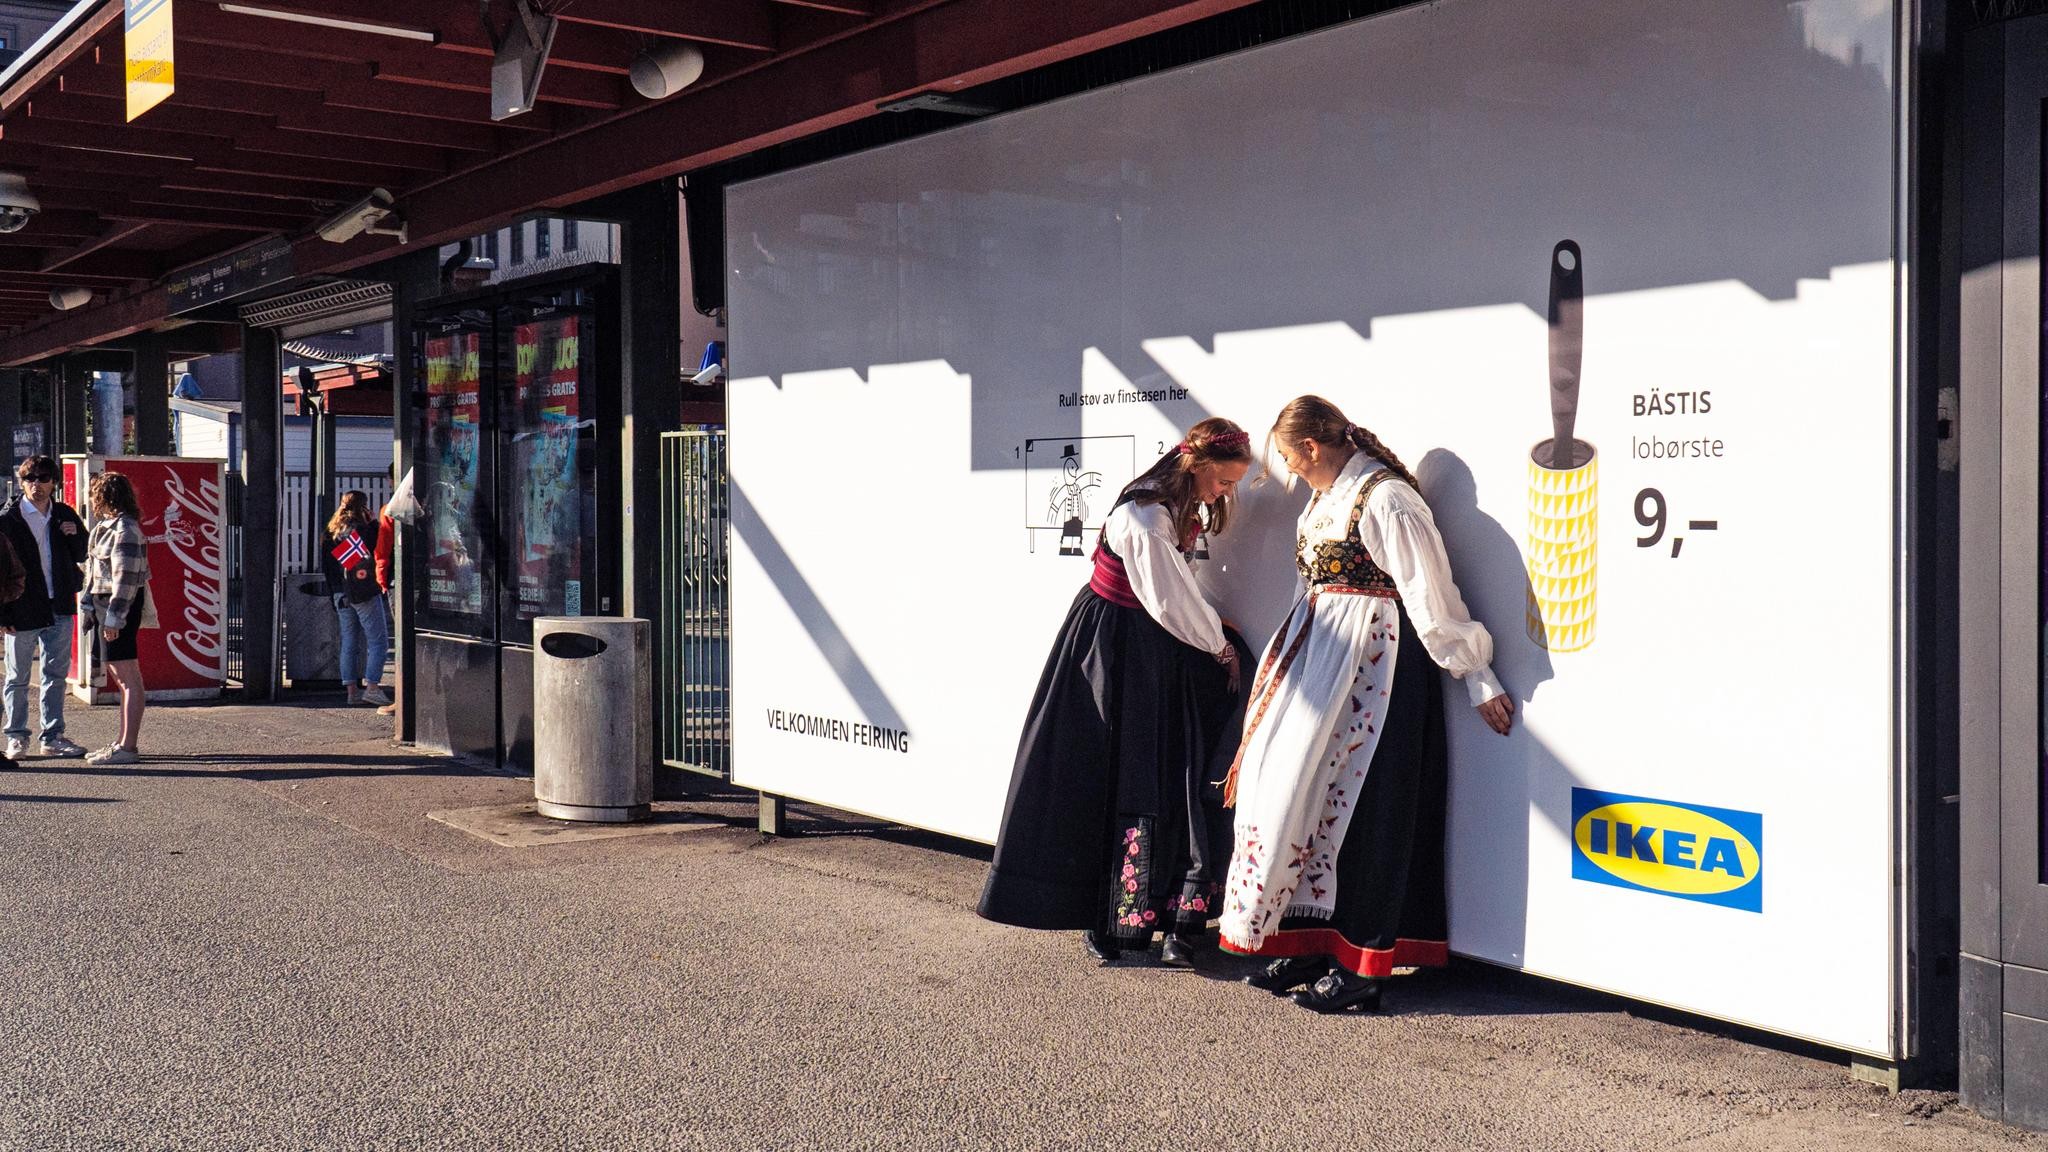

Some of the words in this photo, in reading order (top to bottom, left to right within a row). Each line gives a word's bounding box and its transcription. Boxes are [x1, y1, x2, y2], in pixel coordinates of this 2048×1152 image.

[552, 381, 577, 396] GRATIS
[1059, 392, 1077, 407] Rull
[1080, 393, 1100, 406] støv
[1103, 393, 1115, 405] av
[1118, 388, 1166, 404] finstasen
[1169, 386, 1189, 401] her
[1633, 388, 1711, 416] BÄSTIS
[1014, 445, 1020, 459] 1
[1157, 441, 1164, 455] 2
[1633, 435, 1724, 459] lobørste
[766, 708, 849, 743] VELKOMMEN
[853, 722, 908, 753] FEIRING
[1590, 817, 1745, 878] IKEA
